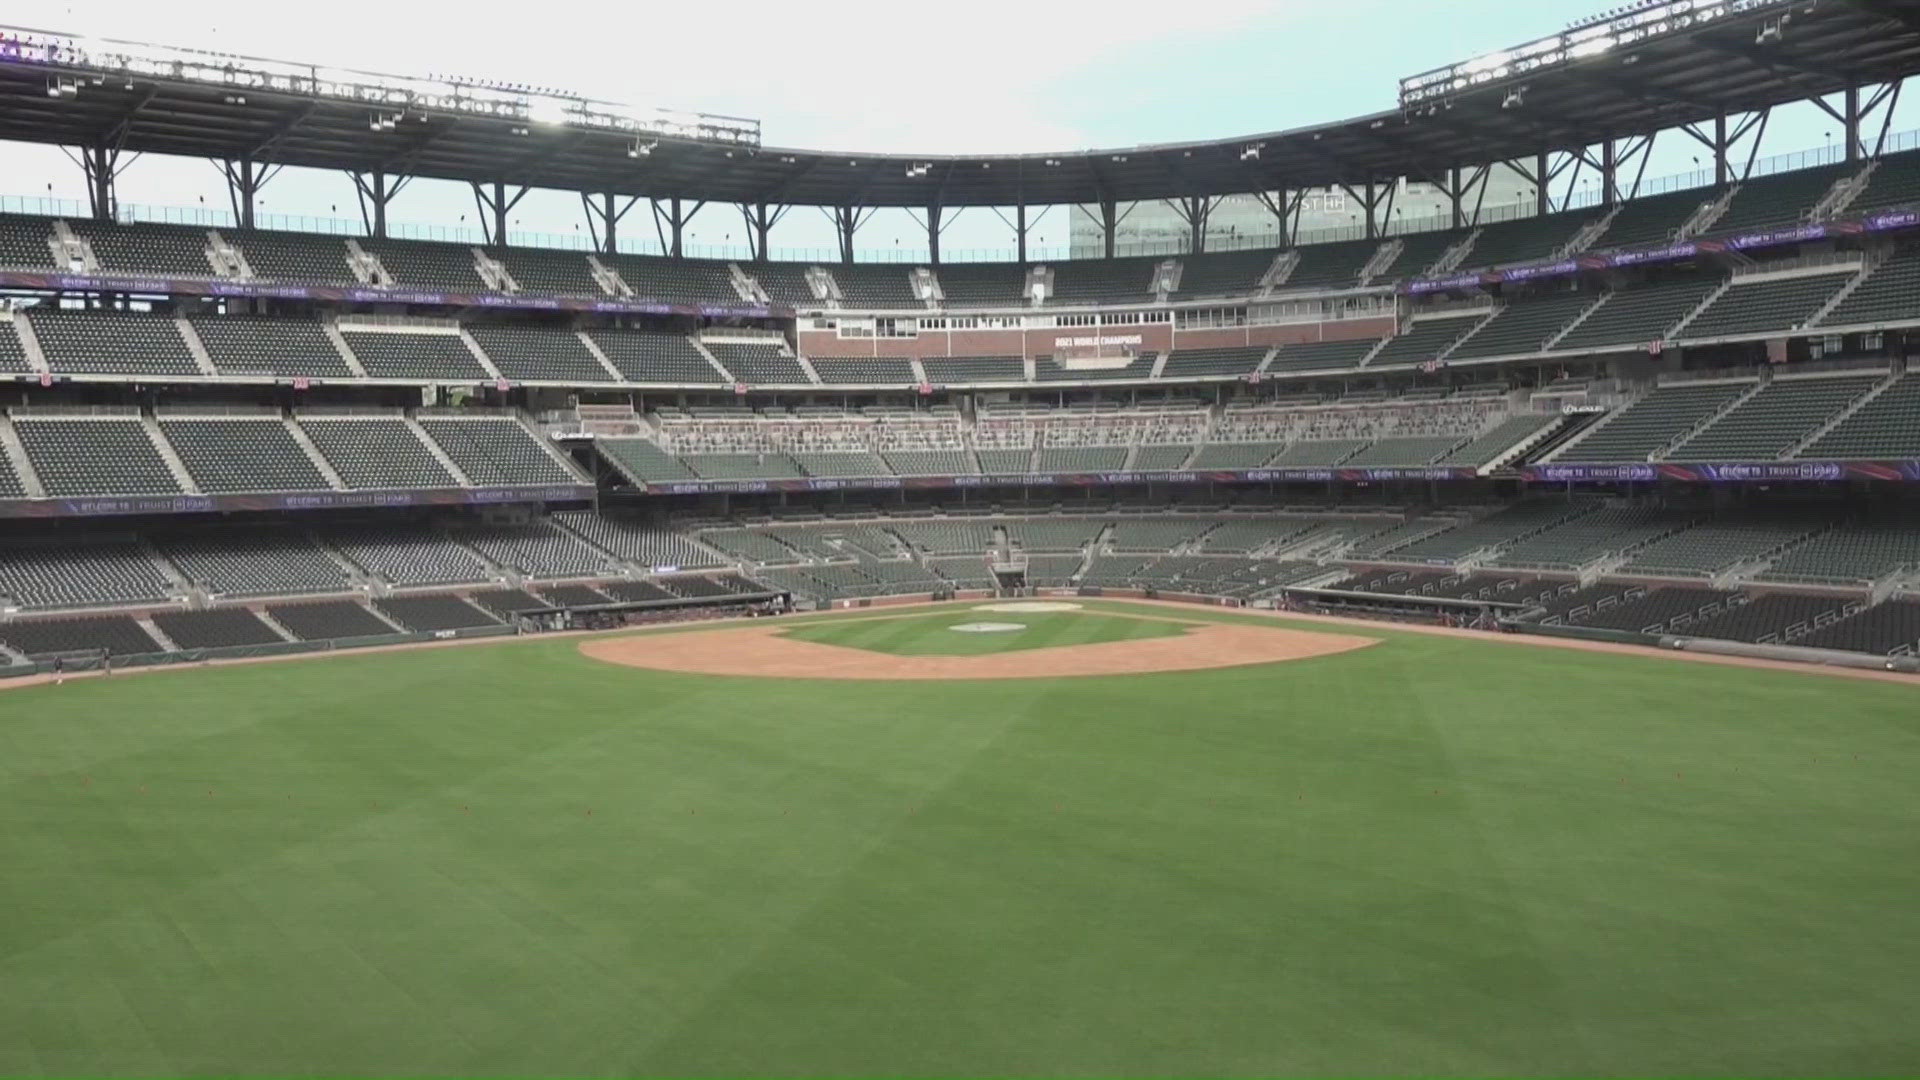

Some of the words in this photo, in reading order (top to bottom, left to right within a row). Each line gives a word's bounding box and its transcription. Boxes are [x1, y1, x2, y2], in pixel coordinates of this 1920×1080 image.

[1055, 337, 1073, 347] 2021
[1073, 336, 1099, 347] WORLD
[1100, 334, 1142, 345] CHAMPIONS
[1590, 468, 1619, 477] TRUIST
[1719, 466, 1750, 477] WELCOME
[1768, 466, 1800, 476] TRUIST
[1813, 465, 1840, 477] PARK
[81, 501, 117, 511] WELCOME
[139, 501, 172, 509] TRUIST
[185, 499, 213, 509] PARK
[286, 496, 320, 505] WELCOME
[342, 495, 373, 503] TRUIST
[386, 493, 412, 502] PARK
